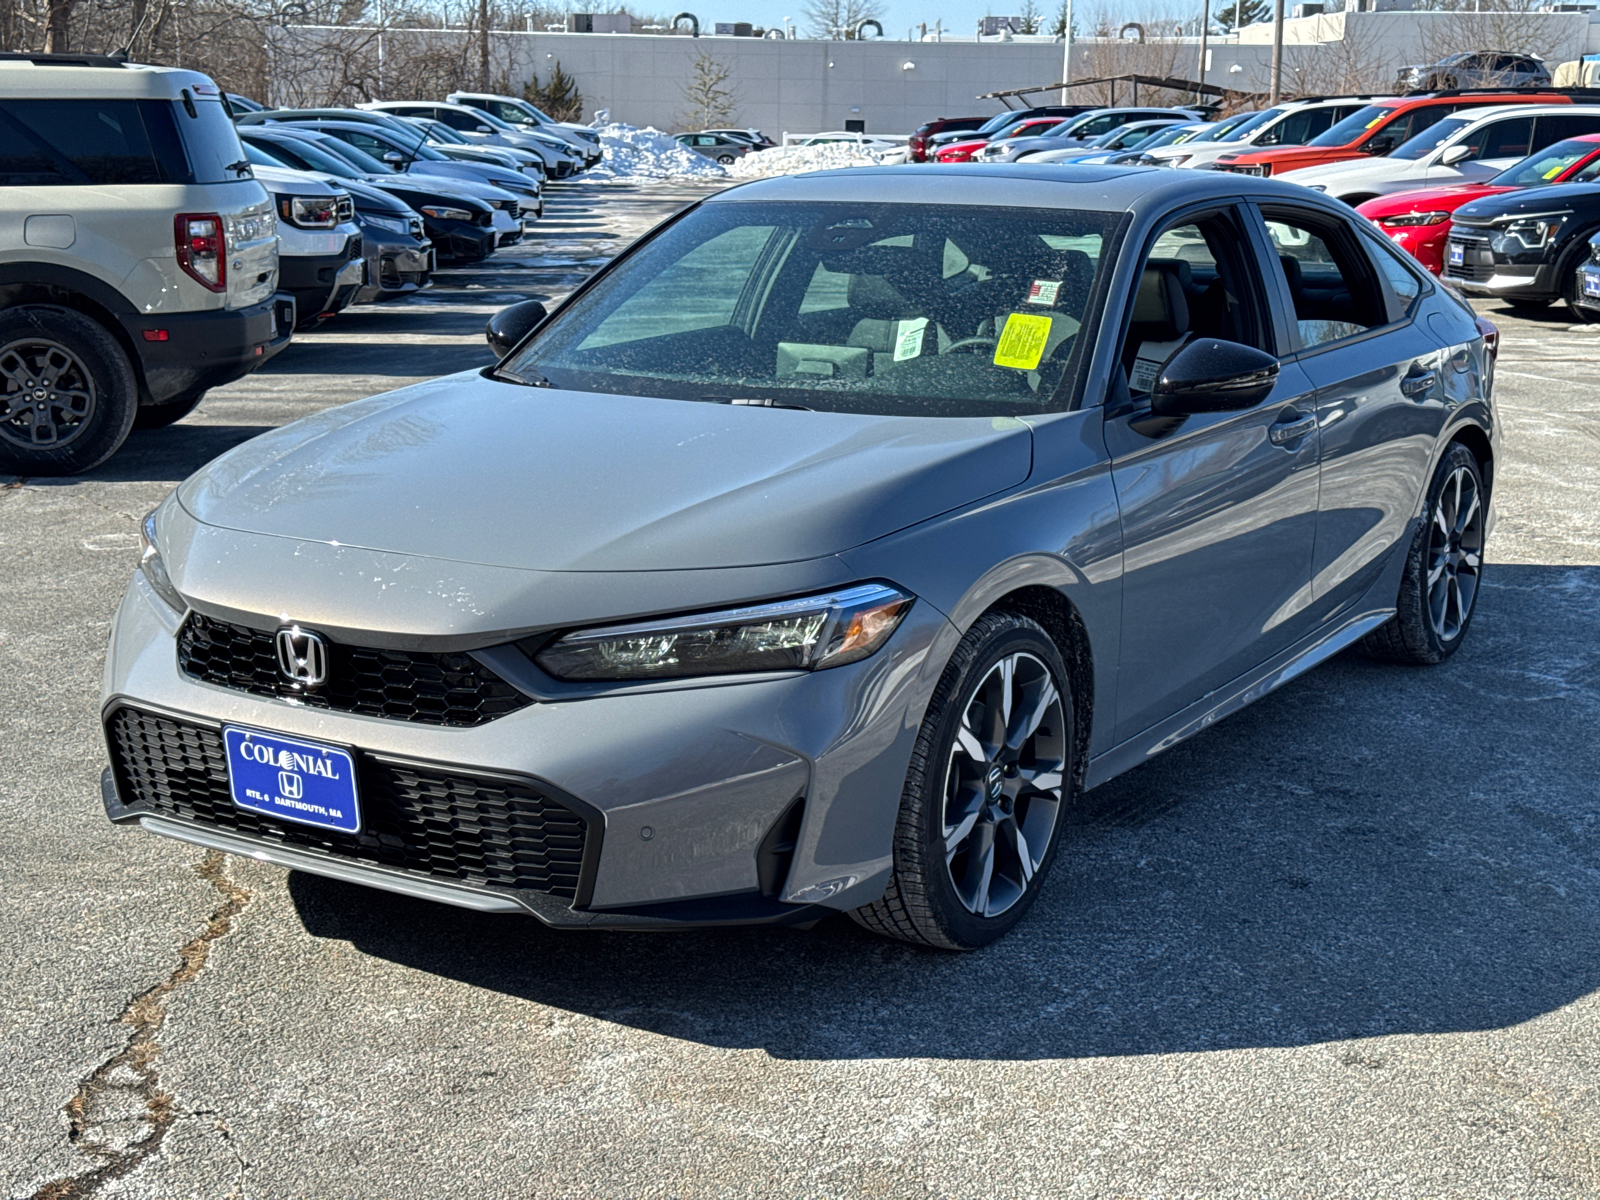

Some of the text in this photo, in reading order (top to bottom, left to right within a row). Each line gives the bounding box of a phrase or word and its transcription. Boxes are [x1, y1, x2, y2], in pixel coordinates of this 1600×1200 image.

[240, 741, 340, 780] COLONIAL
[245, 788, 263, 801] RTE.
[274, 796, 328, 817] DARTMOUTH,
[329, 808, 343, 819] MA
